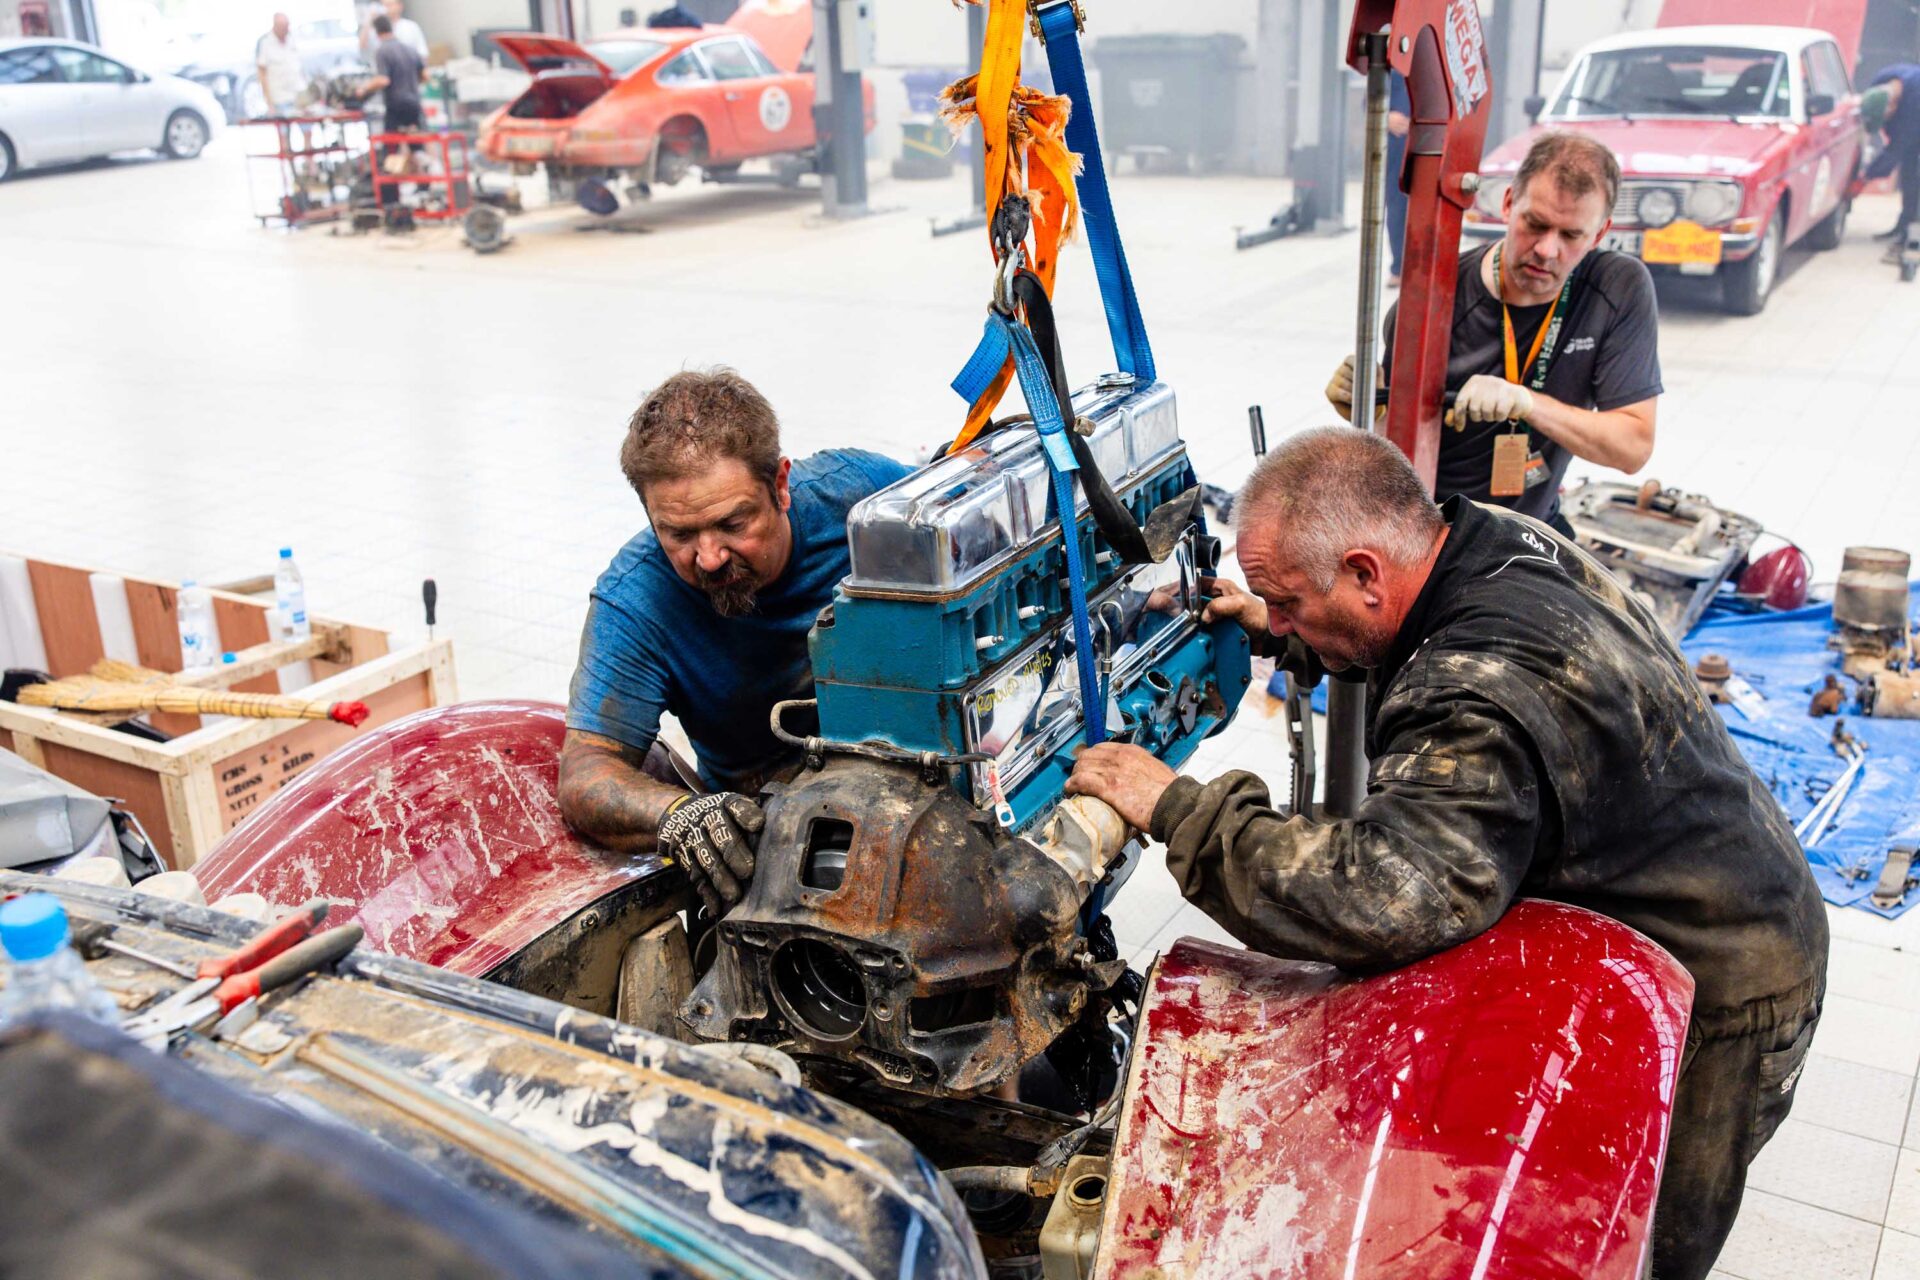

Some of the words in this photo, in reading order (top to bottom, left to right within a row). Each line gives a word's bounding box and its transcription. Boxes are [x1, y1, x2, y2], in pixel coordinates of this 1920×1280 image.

[225, 773, 263, 798] GROSS
[282, 751, 315, 772] KILOS
[229, 792, 258, 811] NETT
